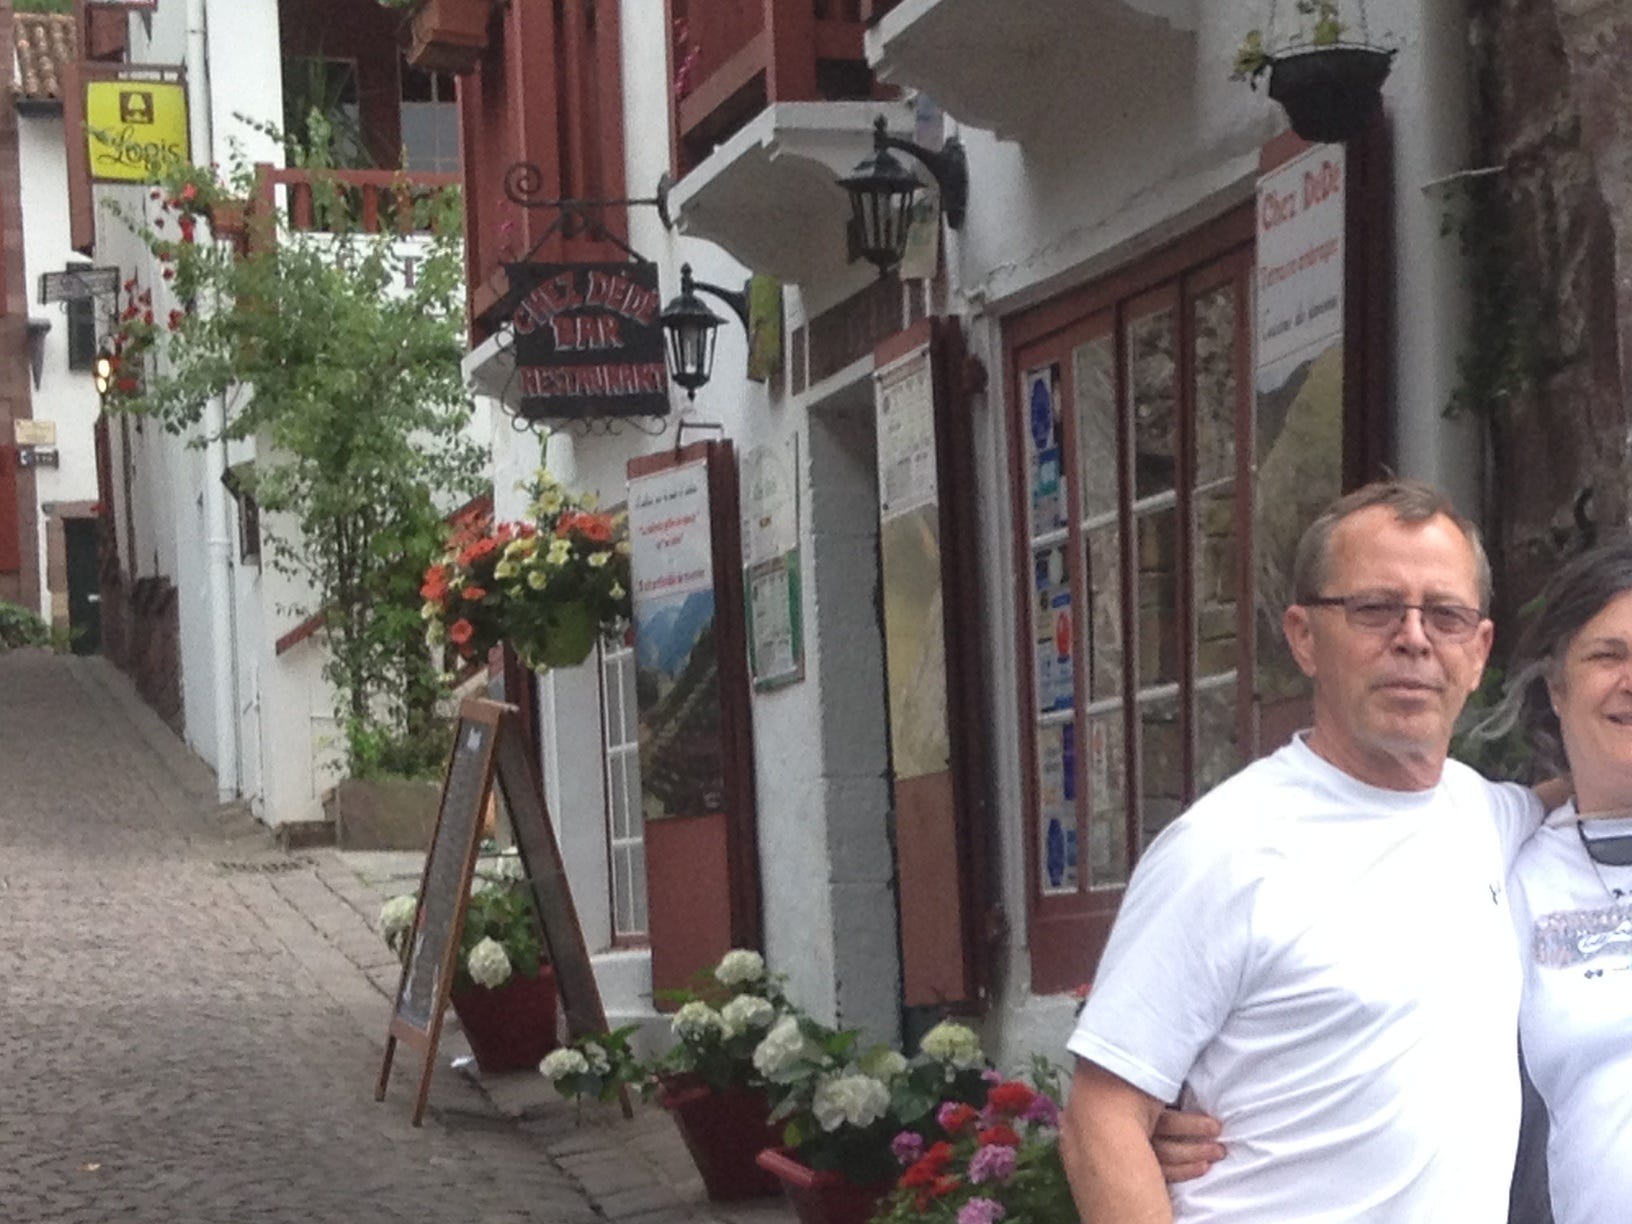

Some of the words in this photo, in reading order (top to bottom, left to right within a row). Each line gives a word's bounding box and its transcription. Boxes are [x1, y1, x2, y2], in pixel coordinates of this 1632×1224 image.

[97, 125, 181, 174] Logis
[513, 271, 585, 336] CHEZ
[549, 315, 625, 351] BAR
[520, 363, 668, 397] RESTAURANT
